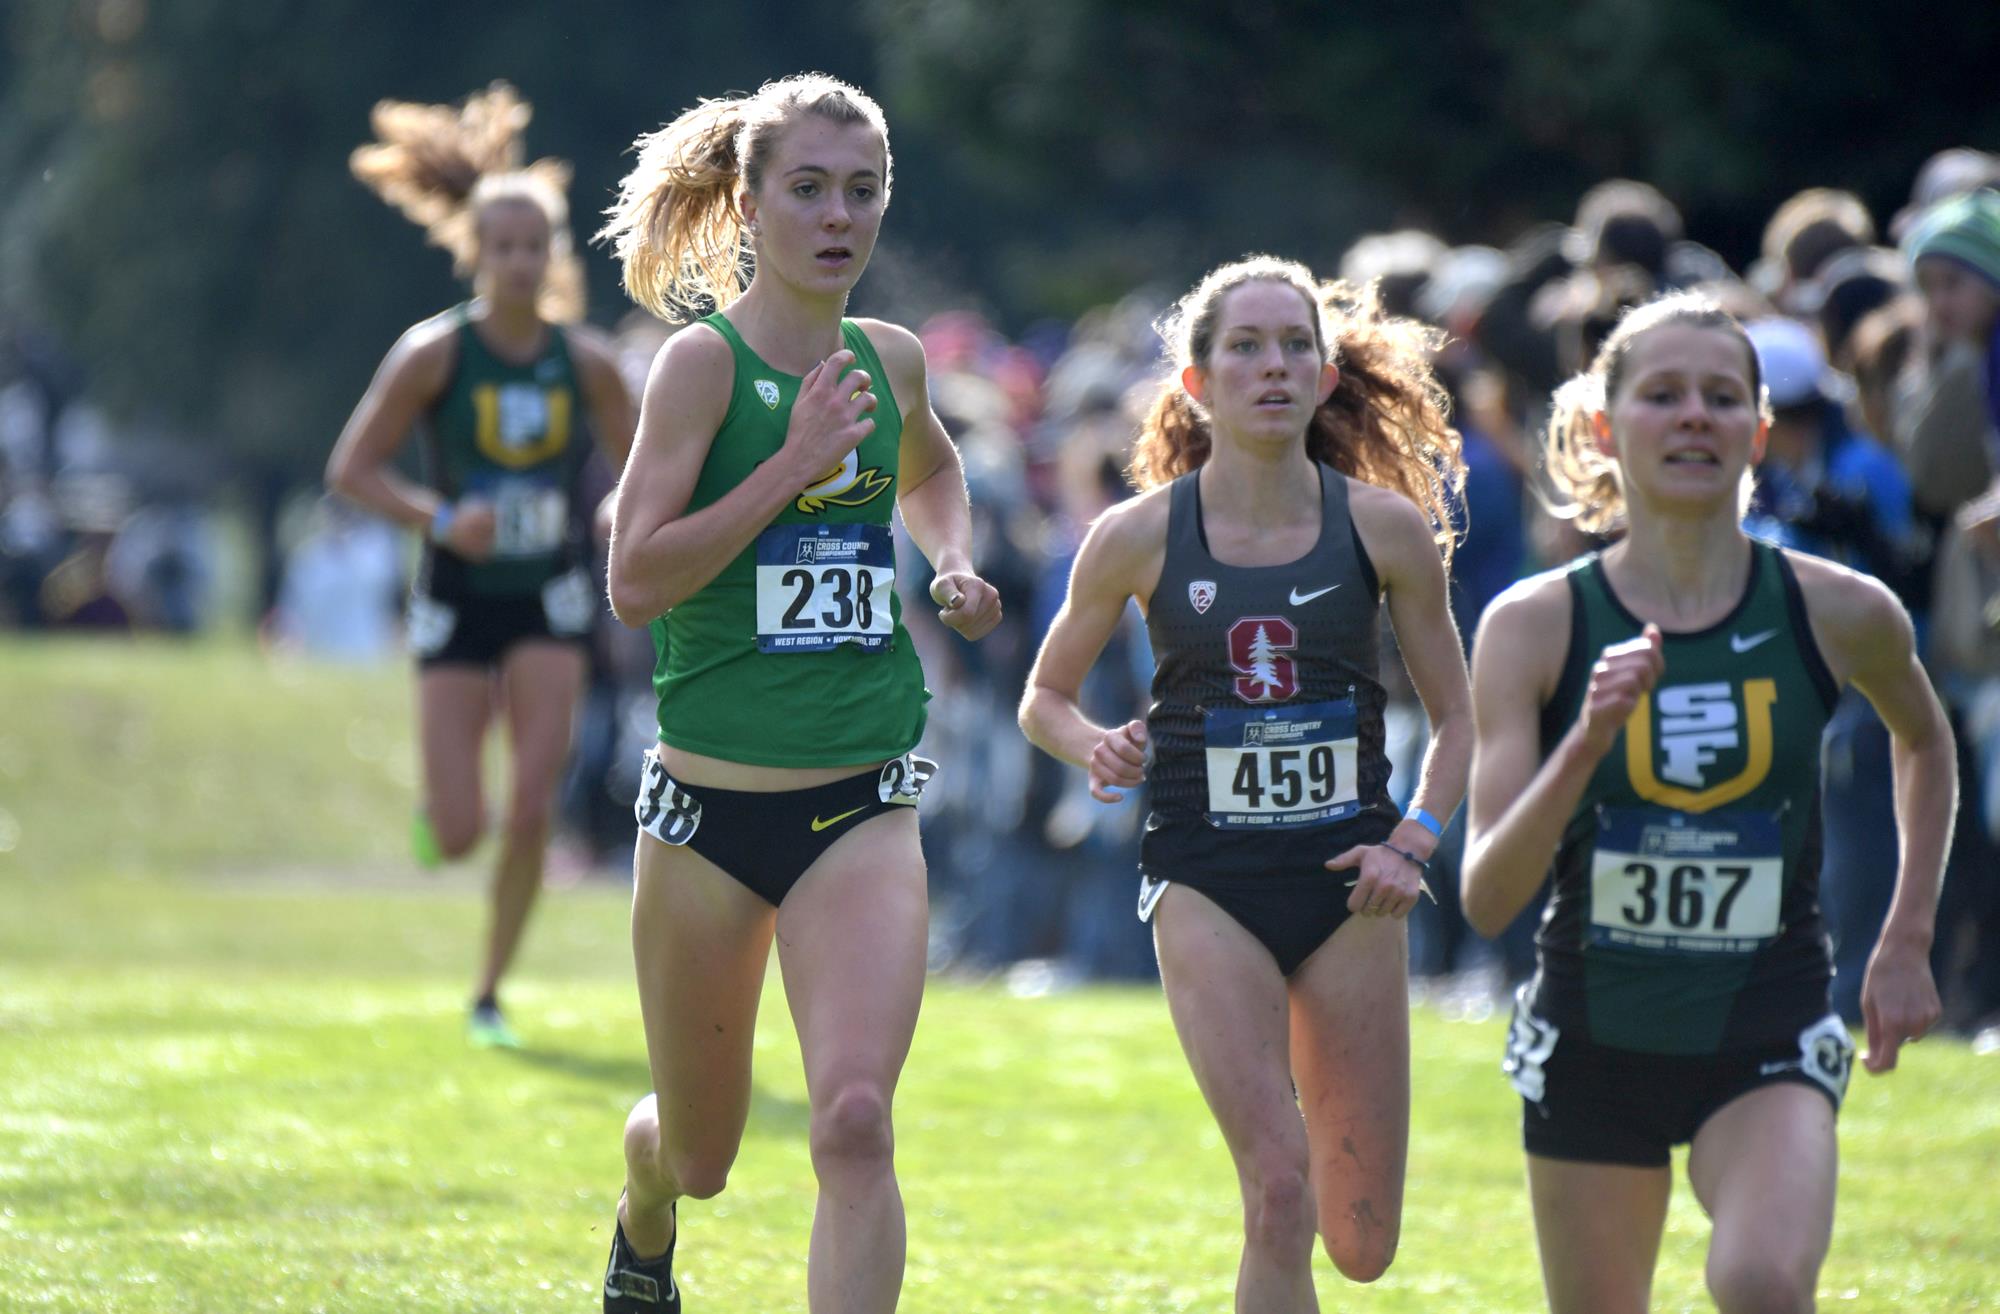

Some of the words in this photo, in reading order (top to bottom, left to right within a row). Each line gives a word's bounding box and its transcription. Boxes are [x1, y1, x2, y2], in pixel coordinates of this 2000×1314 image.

[817, 542, 841, 550] CROSS
[781, 567, 874, 630] 238
[774, 637, 795, 646] WEST
[796, 636, 823, 645] REGION
[1226, 616, 1299, 704] S
[1231, 745, 1336, 808] 459
[1621, 863, 1752, 930] 367
